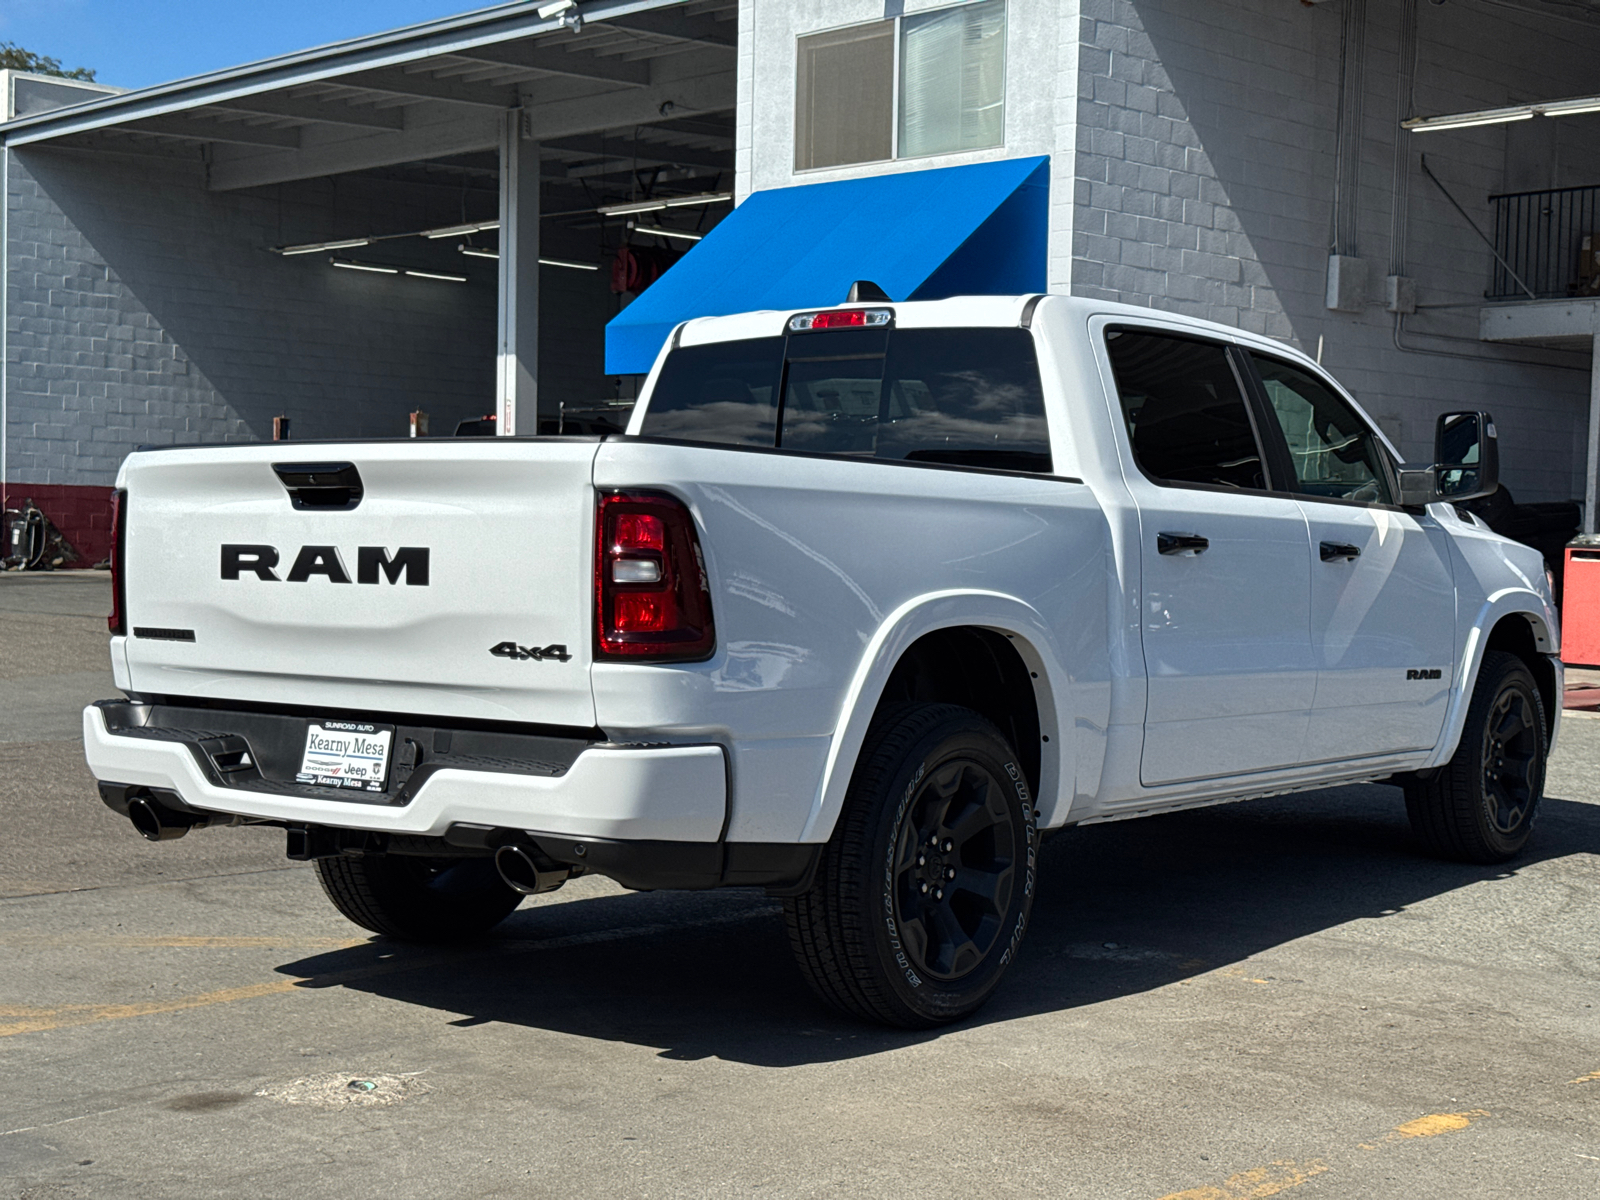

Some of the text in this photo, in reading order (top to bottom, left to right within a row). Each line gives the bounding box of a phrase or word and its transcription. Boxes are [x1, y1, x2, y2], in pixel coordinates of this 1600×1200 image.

[220, 543, 430, 586] RAM
[488, 641, 573, 663] 4x4
[1406, 669, 1442, 680] RAM
[325, 722, 356, 731] SUNROAD
[309, 734, 385, 758] Kearny Mesa
[344, 763, 367, 778] Jeep
[317, 775, 342, 788] Kearny
[343, 777, 362, 787] Mesa
